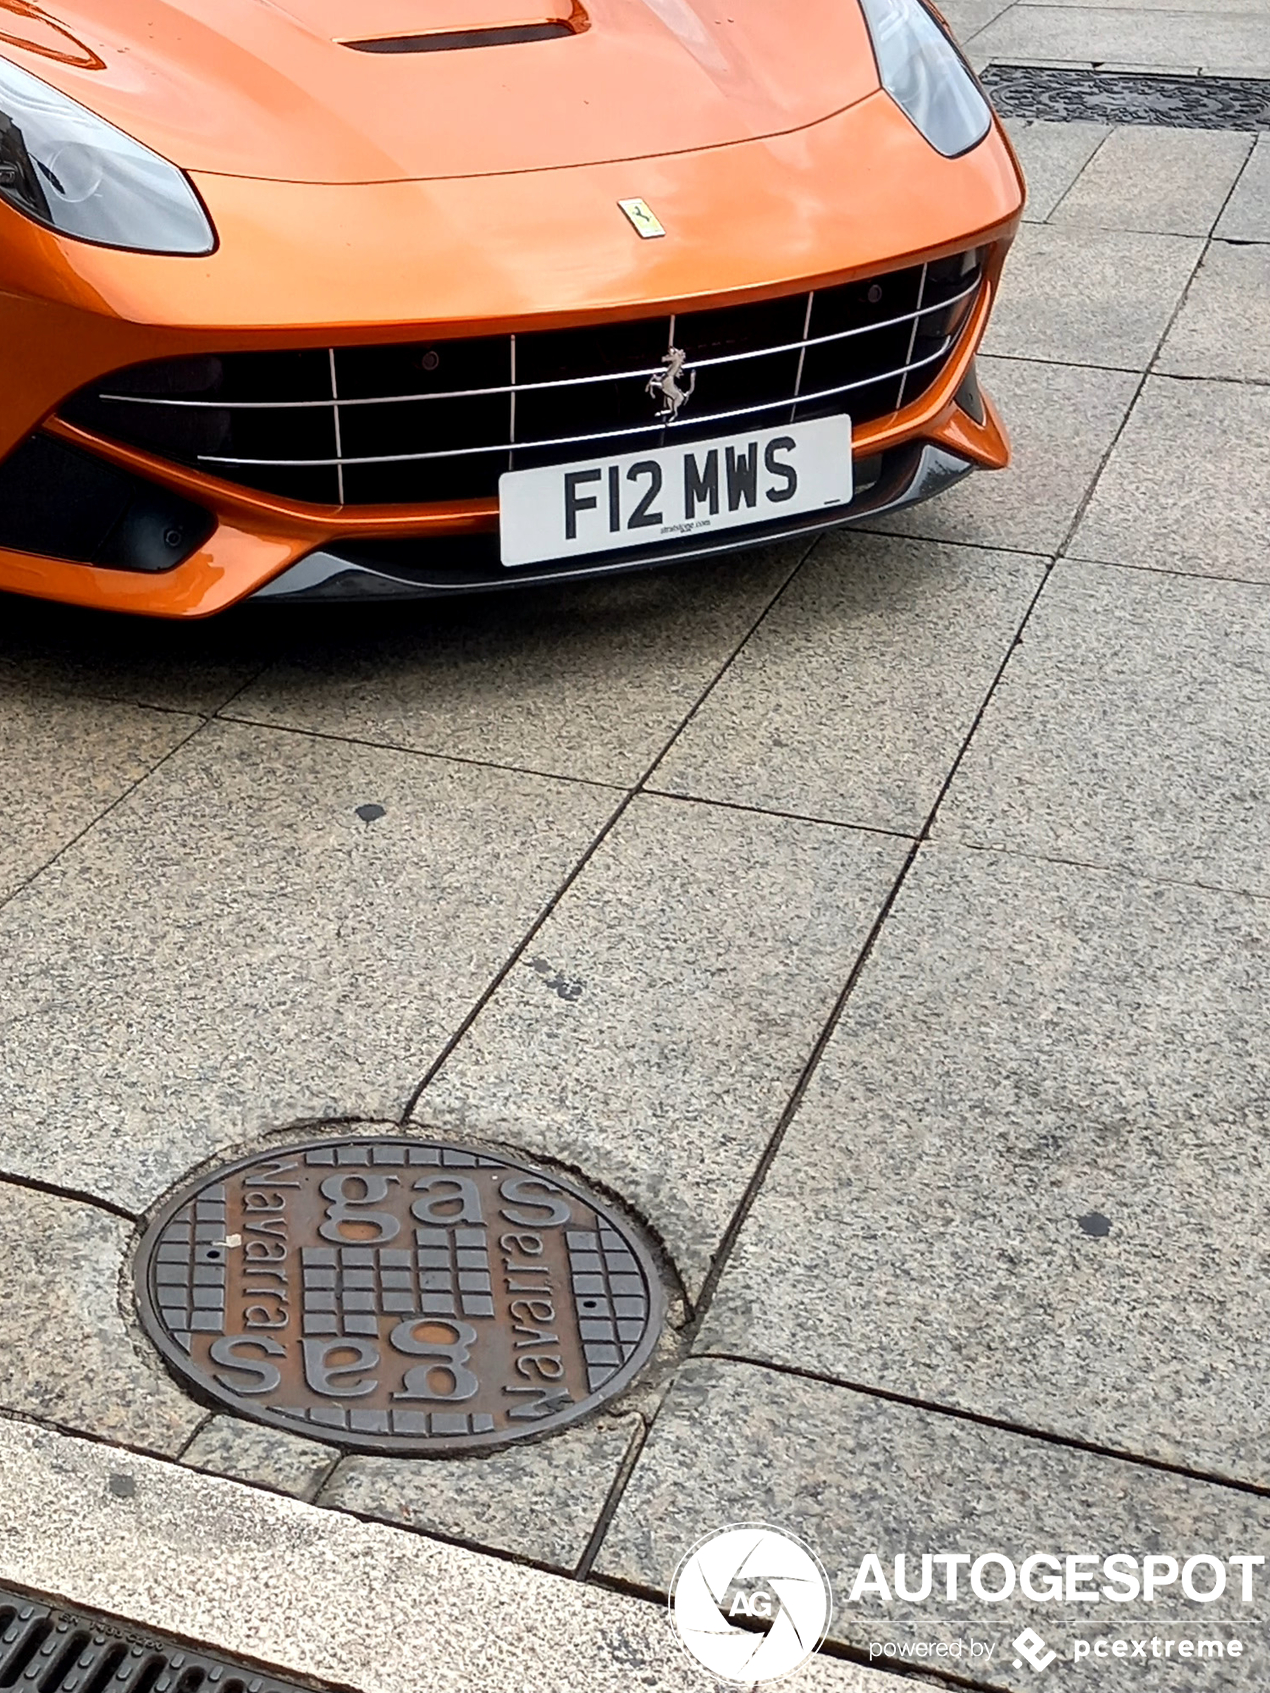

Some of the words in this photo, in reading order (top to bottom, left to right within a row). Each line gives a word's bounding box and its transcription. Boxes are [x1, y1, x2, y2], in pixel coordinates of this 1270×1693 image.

[564, 459, 663, 540] F12
[684, 436, 798, 520] MWS
[242, 1160, 303, 1330] Navarra
[318, 1170, 572, 1244] gas
[209, 1318, 480, 1402] gas
[502, 1231, 572, 1419] Navarra
